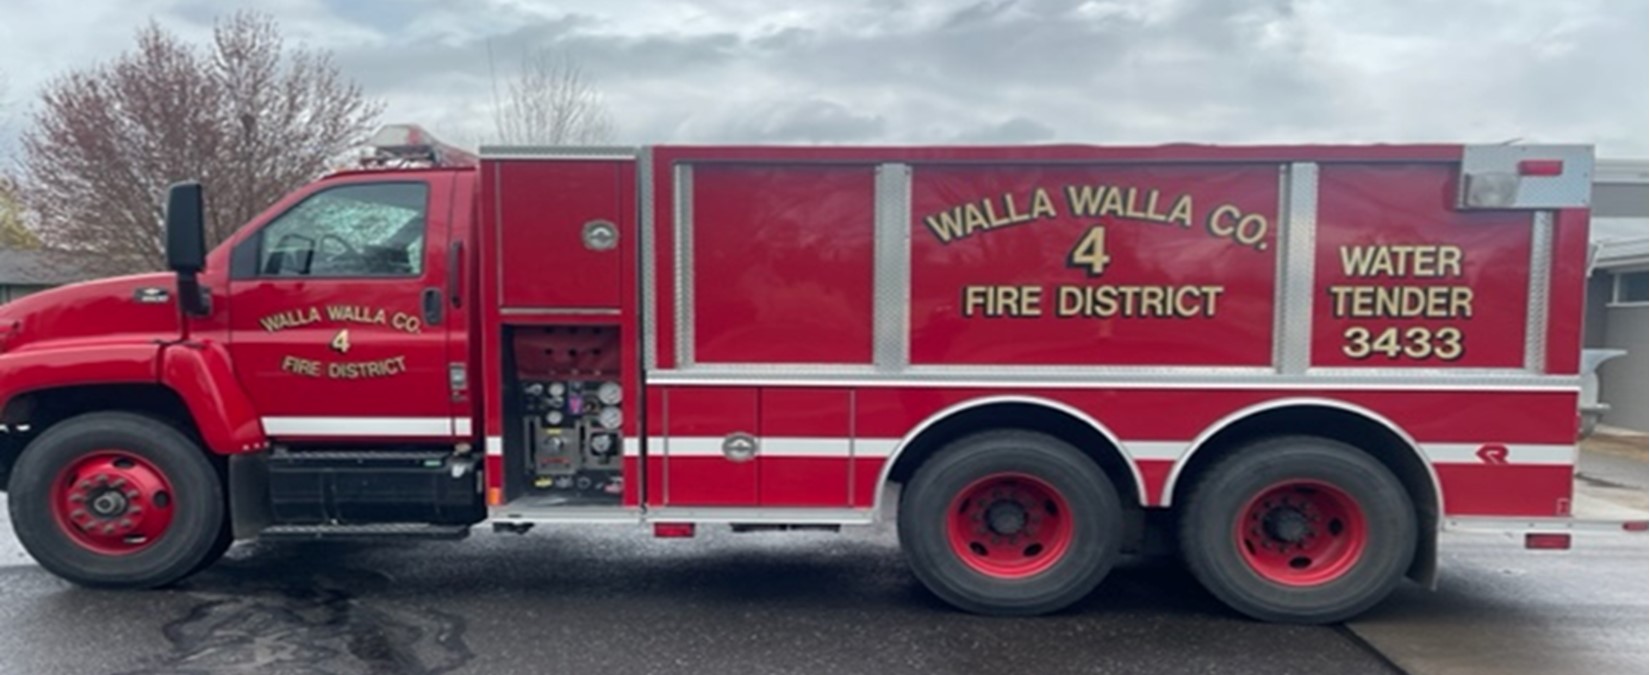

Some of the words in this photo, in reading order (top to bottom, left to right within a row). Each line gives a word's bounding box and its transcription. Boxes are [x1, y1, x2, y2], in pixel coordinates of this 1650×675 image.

[924, 188, 1056, 243] WALLA
[1066, 185, 1194, 227] WALLA
[1208, 204, 1268, 251] CO.
[1067, 226, 1110, 276] 4
[1338, 245, 1463, 278] WATER
[964, 285, 1043, 318] FIRE
[1057, 285, 1225, 318] DISTRICT
[1330, 286, 1475, 319] TENDER
[259, 307, 322, 333] WALLA
[325, 304, 387, 325] WALLA
[330, 328, 351, 353] 4
[1342, 326, 1463, 360] 3433
[281, 355, 322, 377] FIRE
[327, 355, 406, 379] DISTRICT
